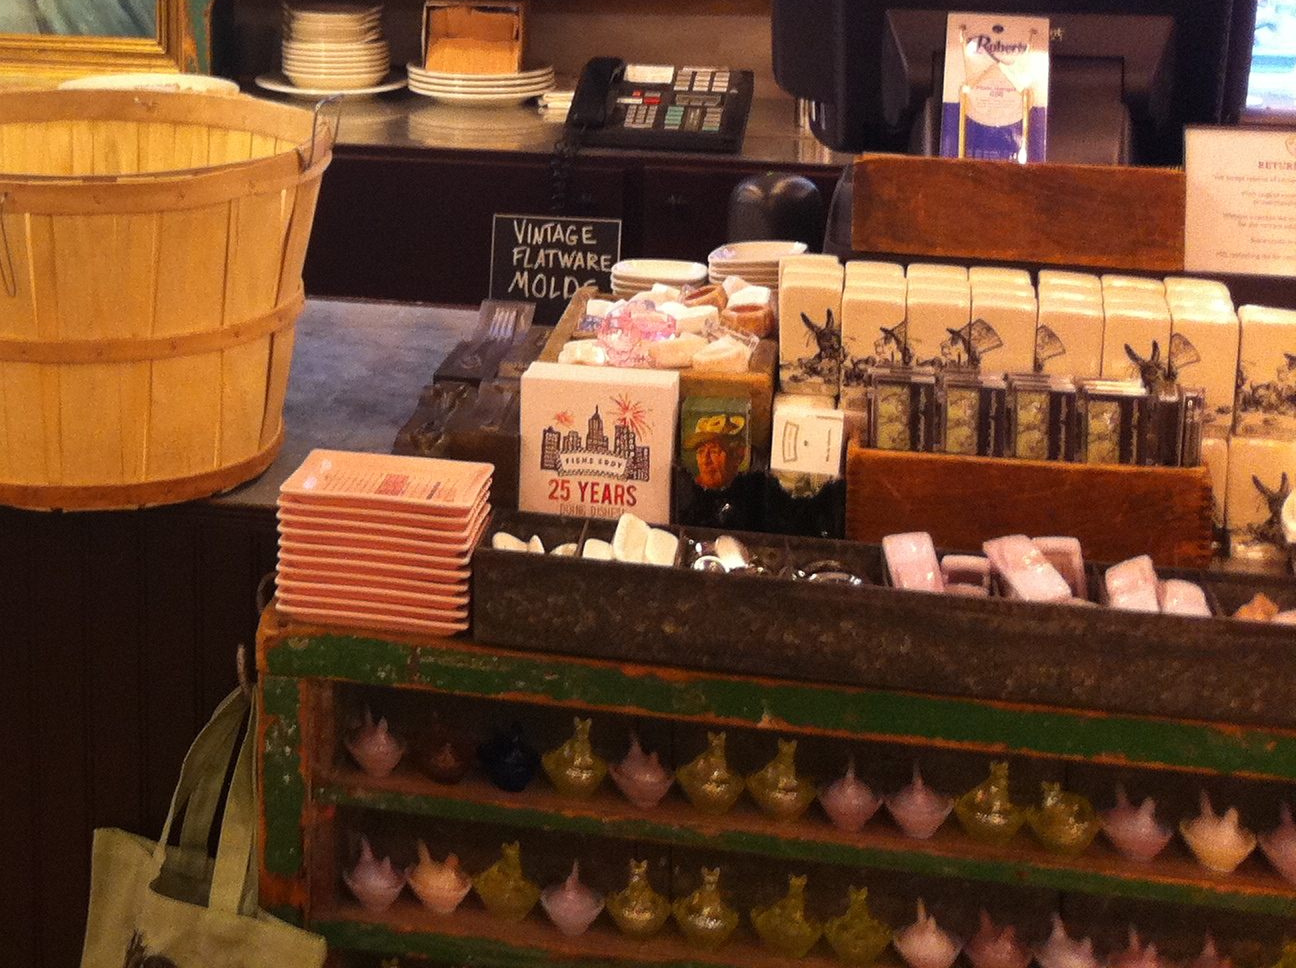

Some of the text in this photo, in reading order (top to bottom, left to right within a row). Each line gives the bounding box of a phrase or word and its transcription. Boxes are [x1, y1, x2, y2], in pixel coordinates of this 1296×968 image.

[513, 219, 597, 246] VINTAGE
[512, 246, 613, 272] FLATWARE
[548, 478, 638, 507] 25 YEARS
